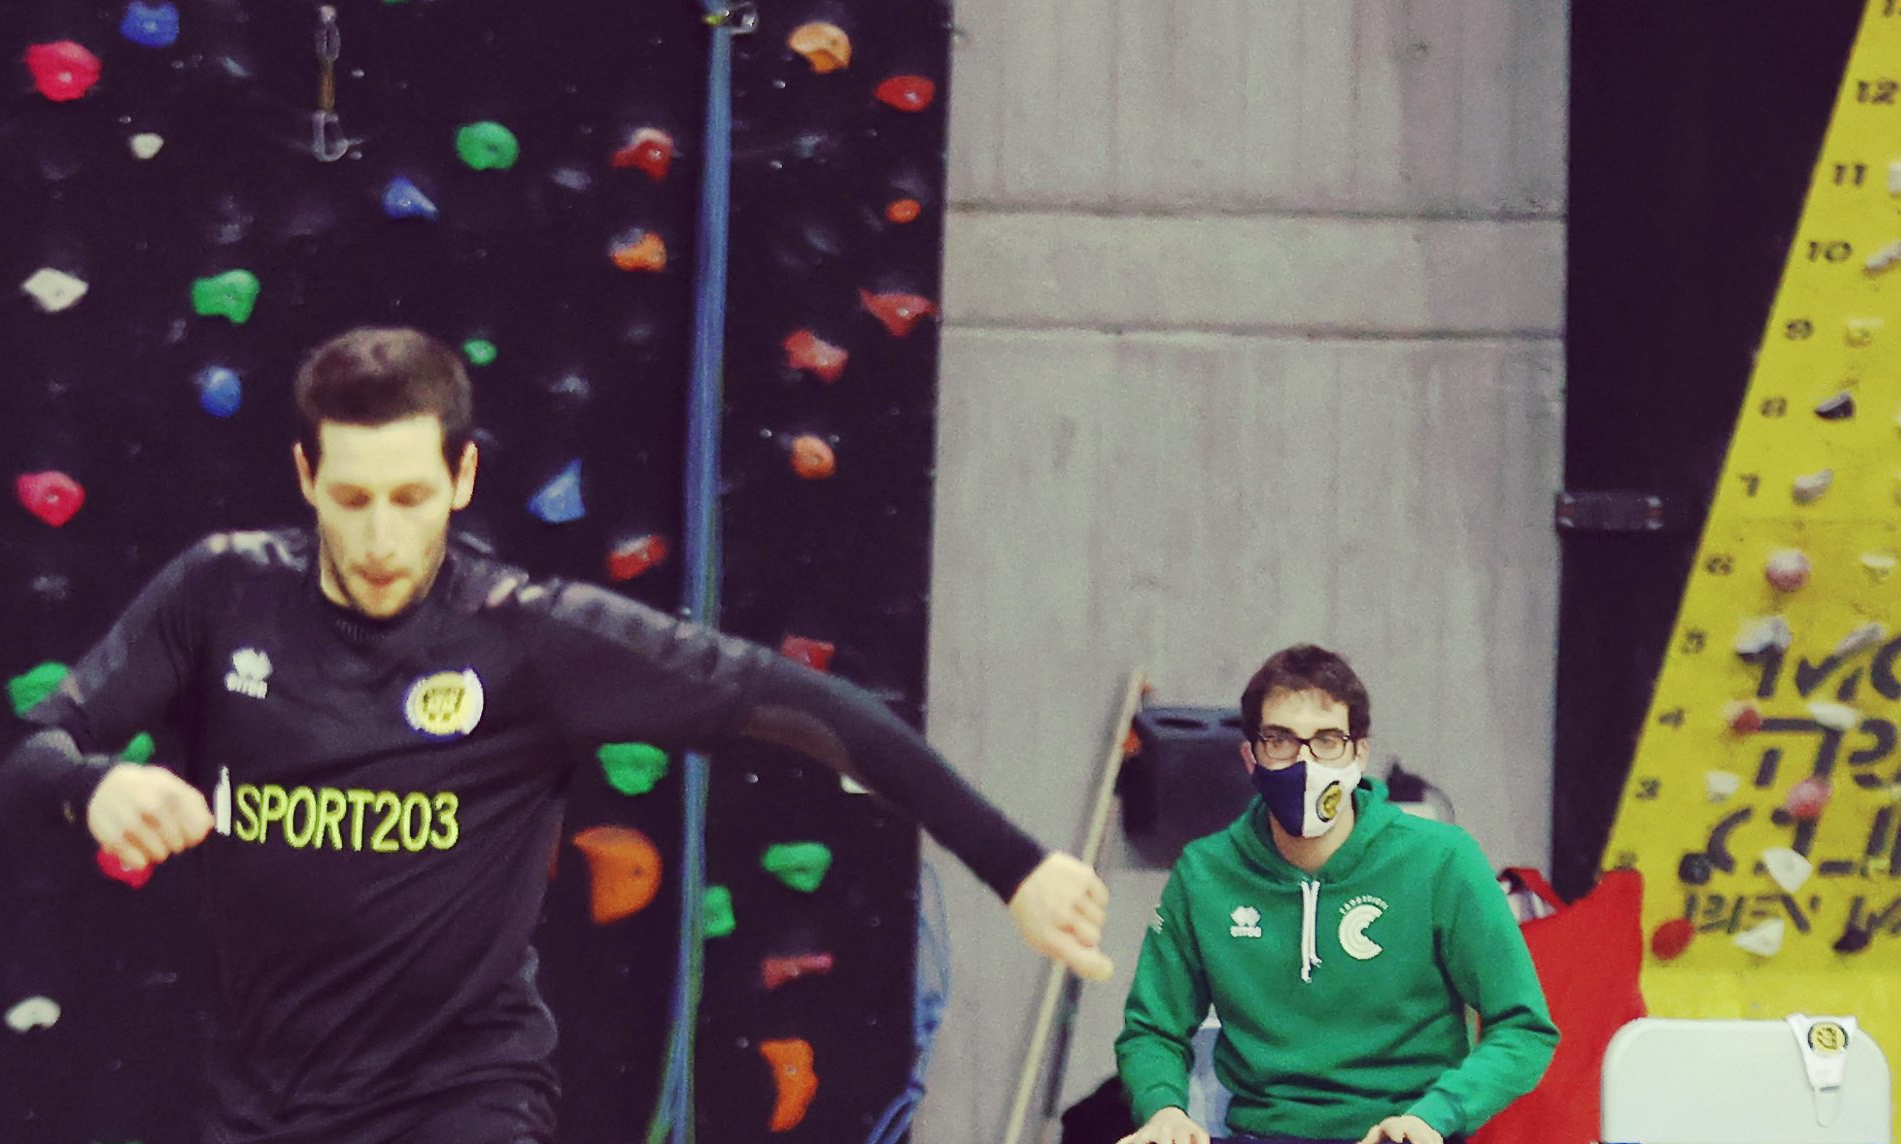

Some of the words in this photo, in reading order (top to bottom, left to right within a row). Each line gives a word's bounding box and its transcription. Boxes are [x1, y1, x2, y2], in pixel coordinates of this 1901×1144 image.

[1856, 79, 1899, 105] 12
[1832, 162, 1868, 187] 11
[1807, 240, 1853, 264] 10
[1739, 473, 1761, 497] 7
